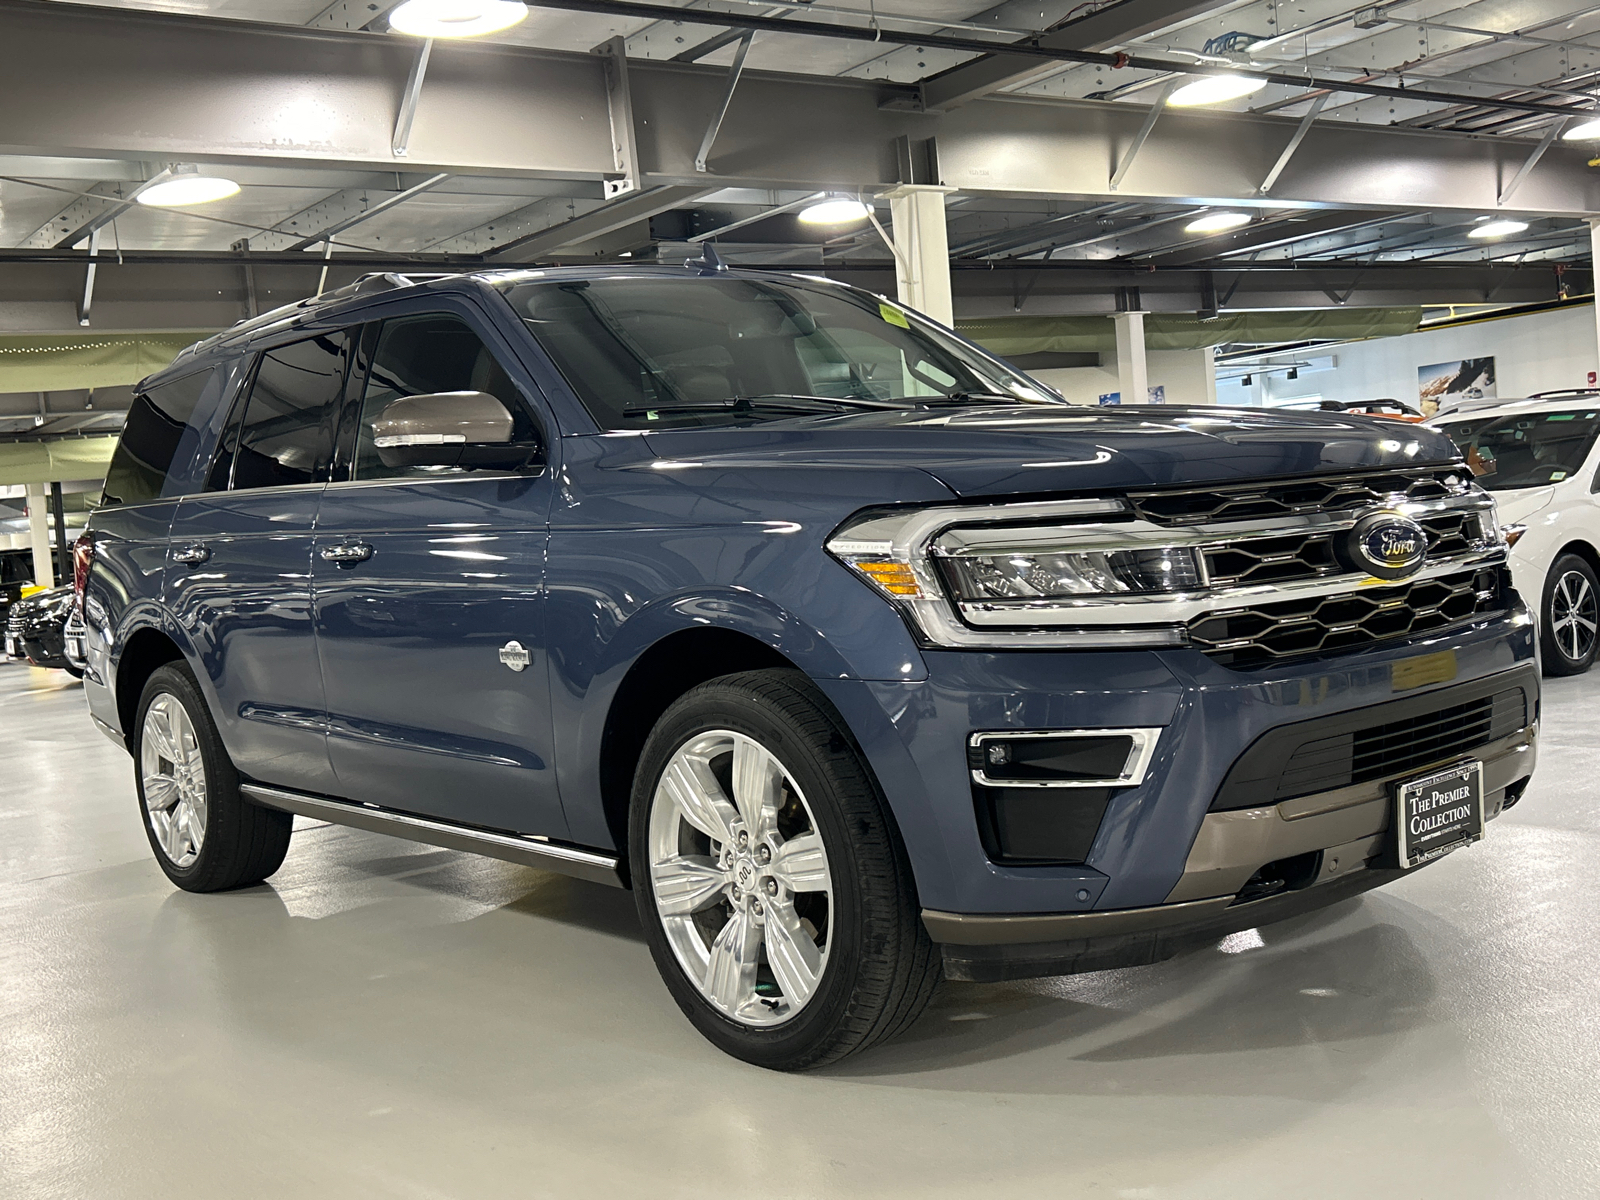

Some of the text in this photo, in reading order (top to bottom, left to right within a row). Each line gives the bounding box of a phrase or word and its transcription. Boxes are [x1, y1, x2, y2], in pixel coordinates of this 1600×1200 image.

[1381, 529, 1416, 556] Ford
[1410, 786, 1470, 815] THE PREMIER
[1410, 804, 1471, 835] COLLECTION
